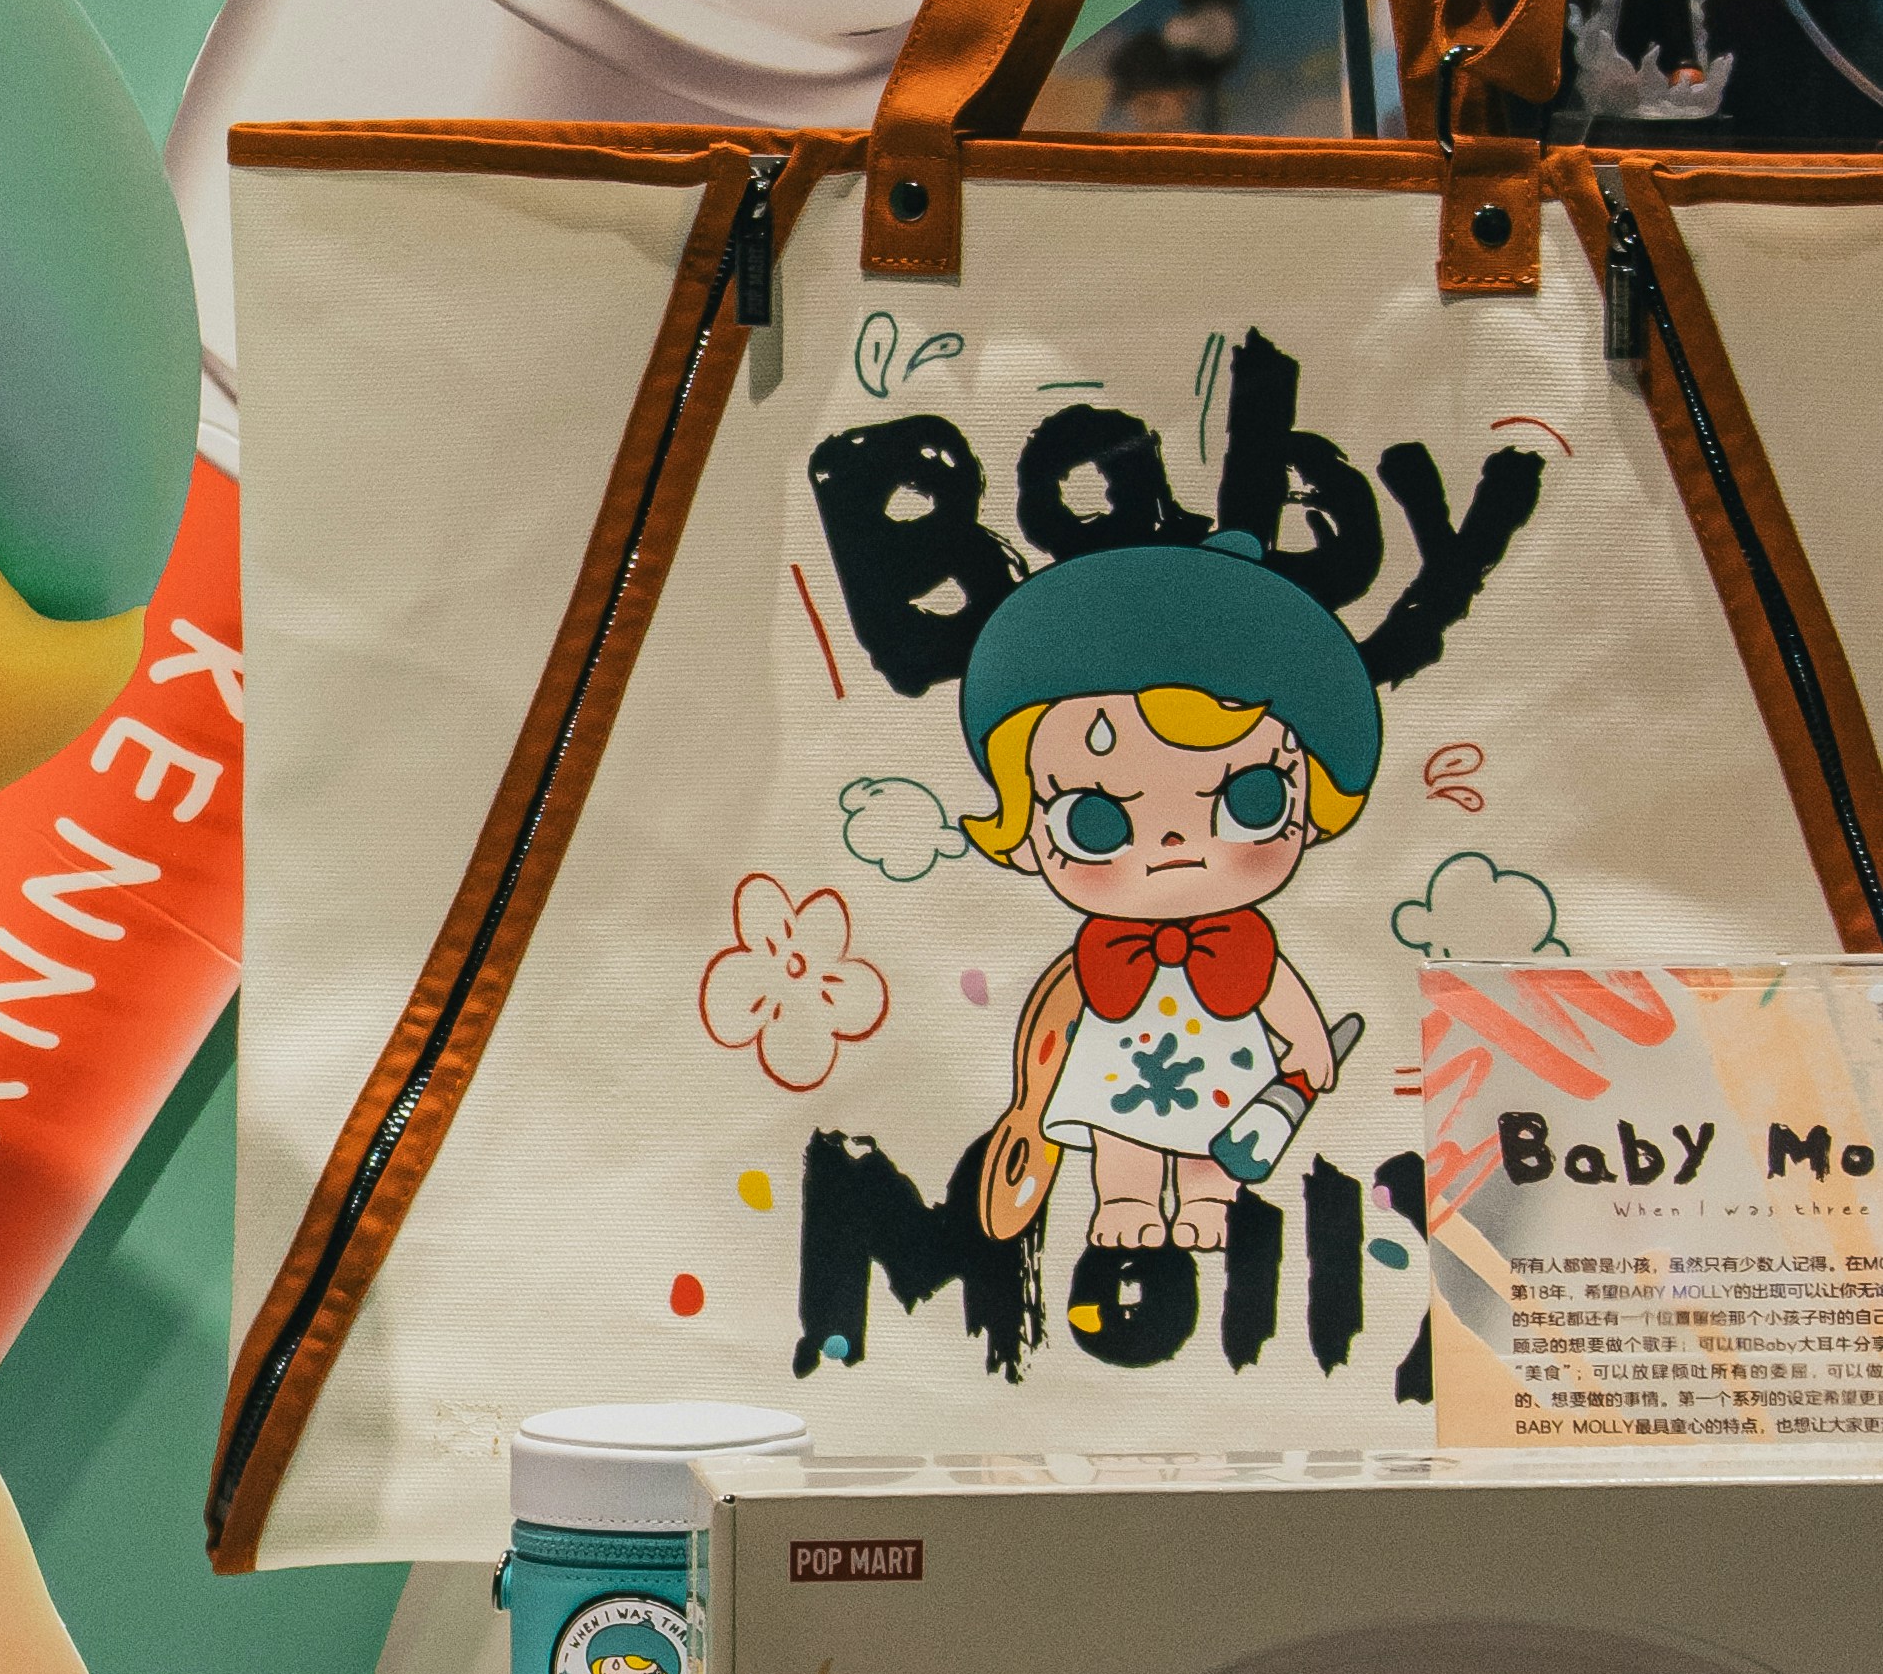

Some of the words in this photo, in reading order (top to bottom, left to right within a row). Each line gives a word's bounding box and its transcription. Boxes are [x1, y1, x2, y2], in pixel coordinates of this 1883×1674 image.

[809, 328, 1545, 697] Baby
[1498, 1111, 1716, 1186] Baby
[1613, 1201, 1680, 1218] When
[1724, 1204, 1775, 1218] was
[1795, 1201, 1871, 1217] three
[796, 1547, 843, 1576] POP
[850, 1546, 917, 1575] MART
[569, 1615, 604, 1650] WHEN
[616, 1607, 653, 1620] WAS
